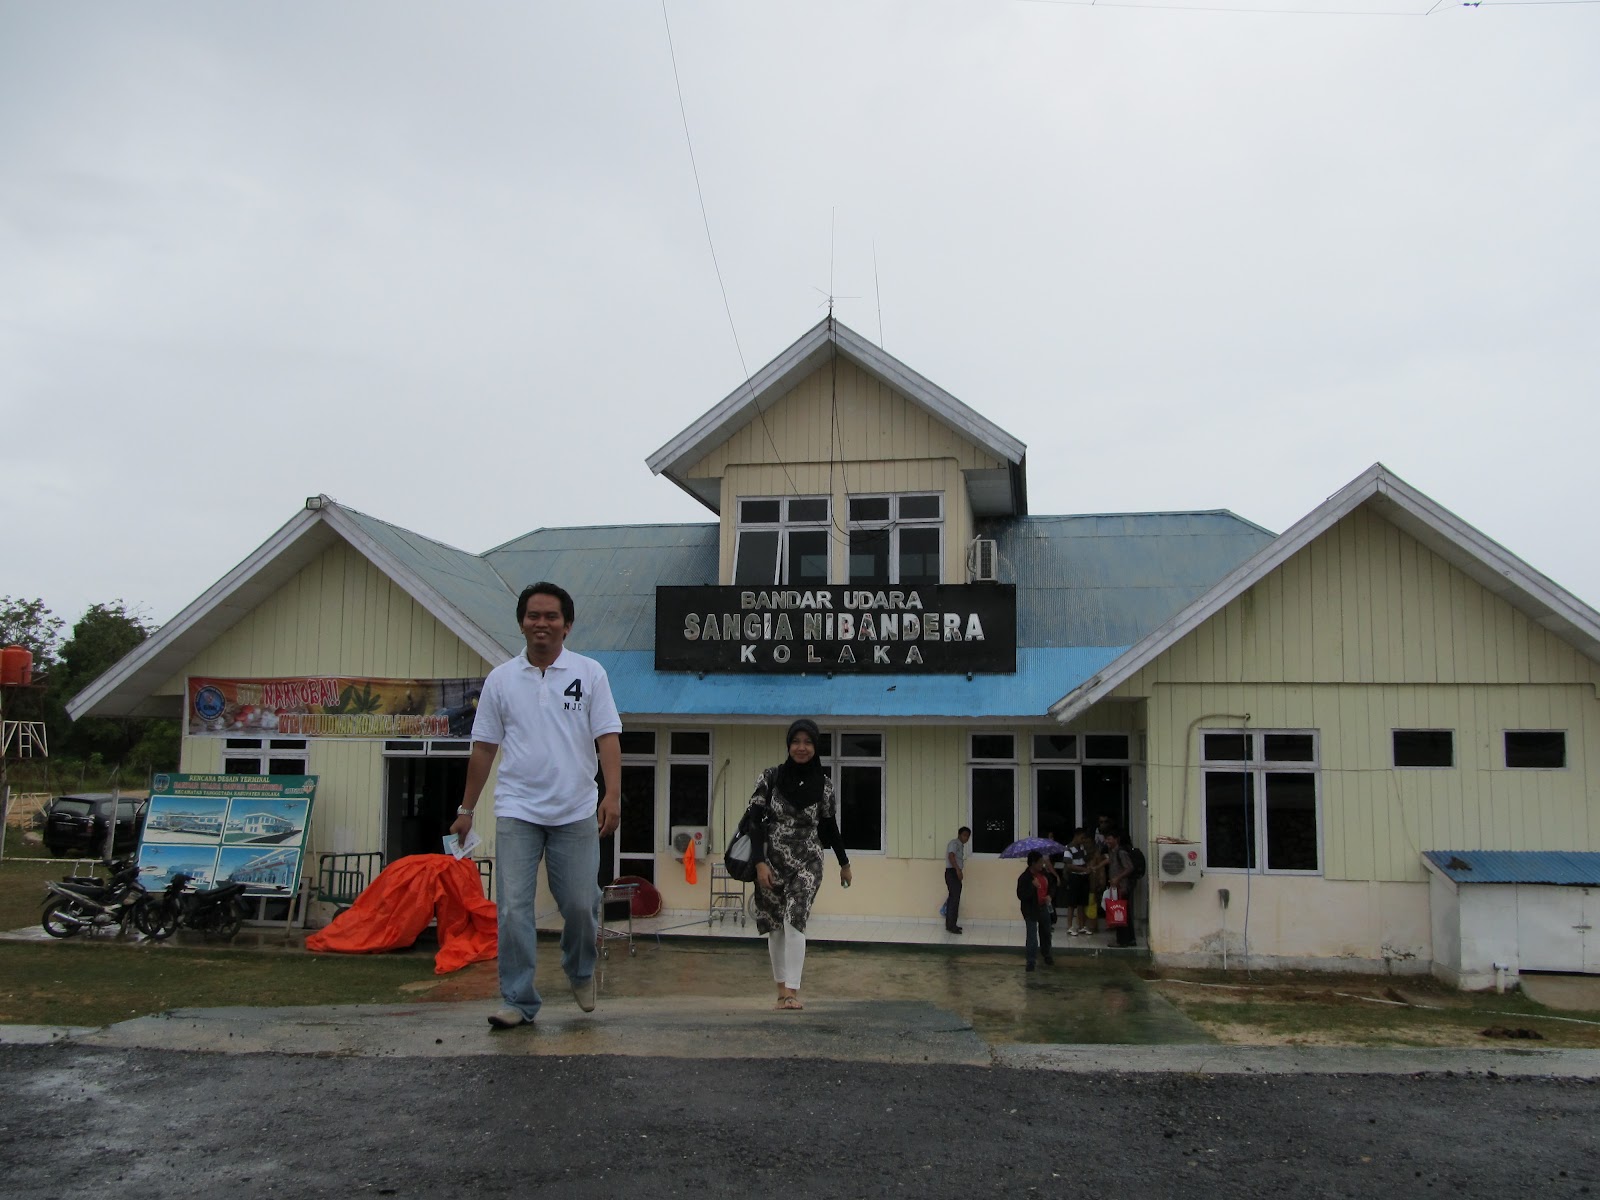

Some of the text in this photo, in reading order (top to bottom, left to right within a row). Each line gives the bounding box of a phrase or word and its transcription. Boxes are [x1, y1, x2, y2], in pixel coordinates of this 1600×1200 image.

[740, 591, 924, 610] BANDAR UDARA
[683, 613, 985, 642] SANGIA NIBANDERA
[740, 645, 924, 664] KOLAKA
[564, 679, 582, 701] 4
[355, 714, 393, 736] KOLAKA
[423, 715, 449, 737] 2014
